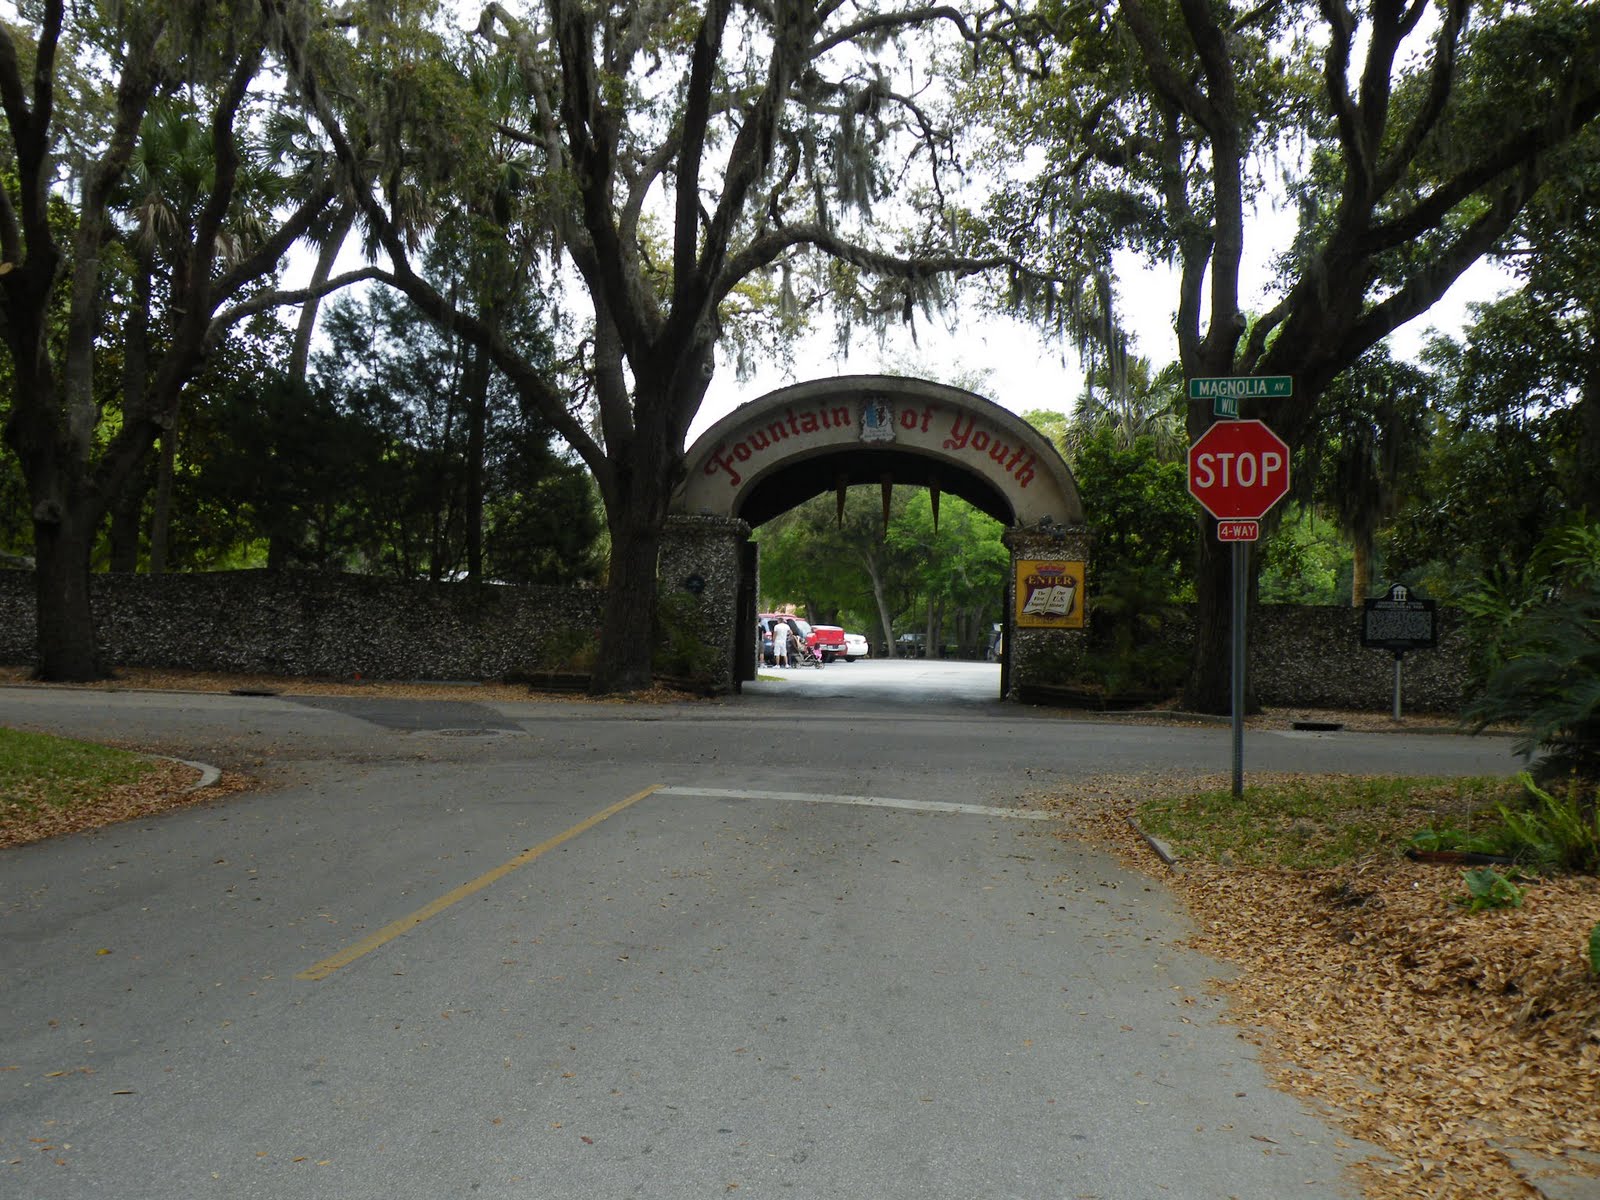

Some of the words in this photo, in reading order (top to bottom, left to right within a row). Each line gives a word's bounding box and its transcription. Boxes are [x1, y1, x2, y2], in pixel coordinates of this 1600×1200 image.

[1200, 380, 1267, 396] MAGNOLIA
[704, 405, 851, 487] Fountain
[900, 403, 941, 433] of
[942, 408, 1037, 488] Youth
[1195, 452, 1282, 488] STOP
[1221, 525, 1255, 537] 4-WAY
[1028, 576, 1072, 585] ENTER
